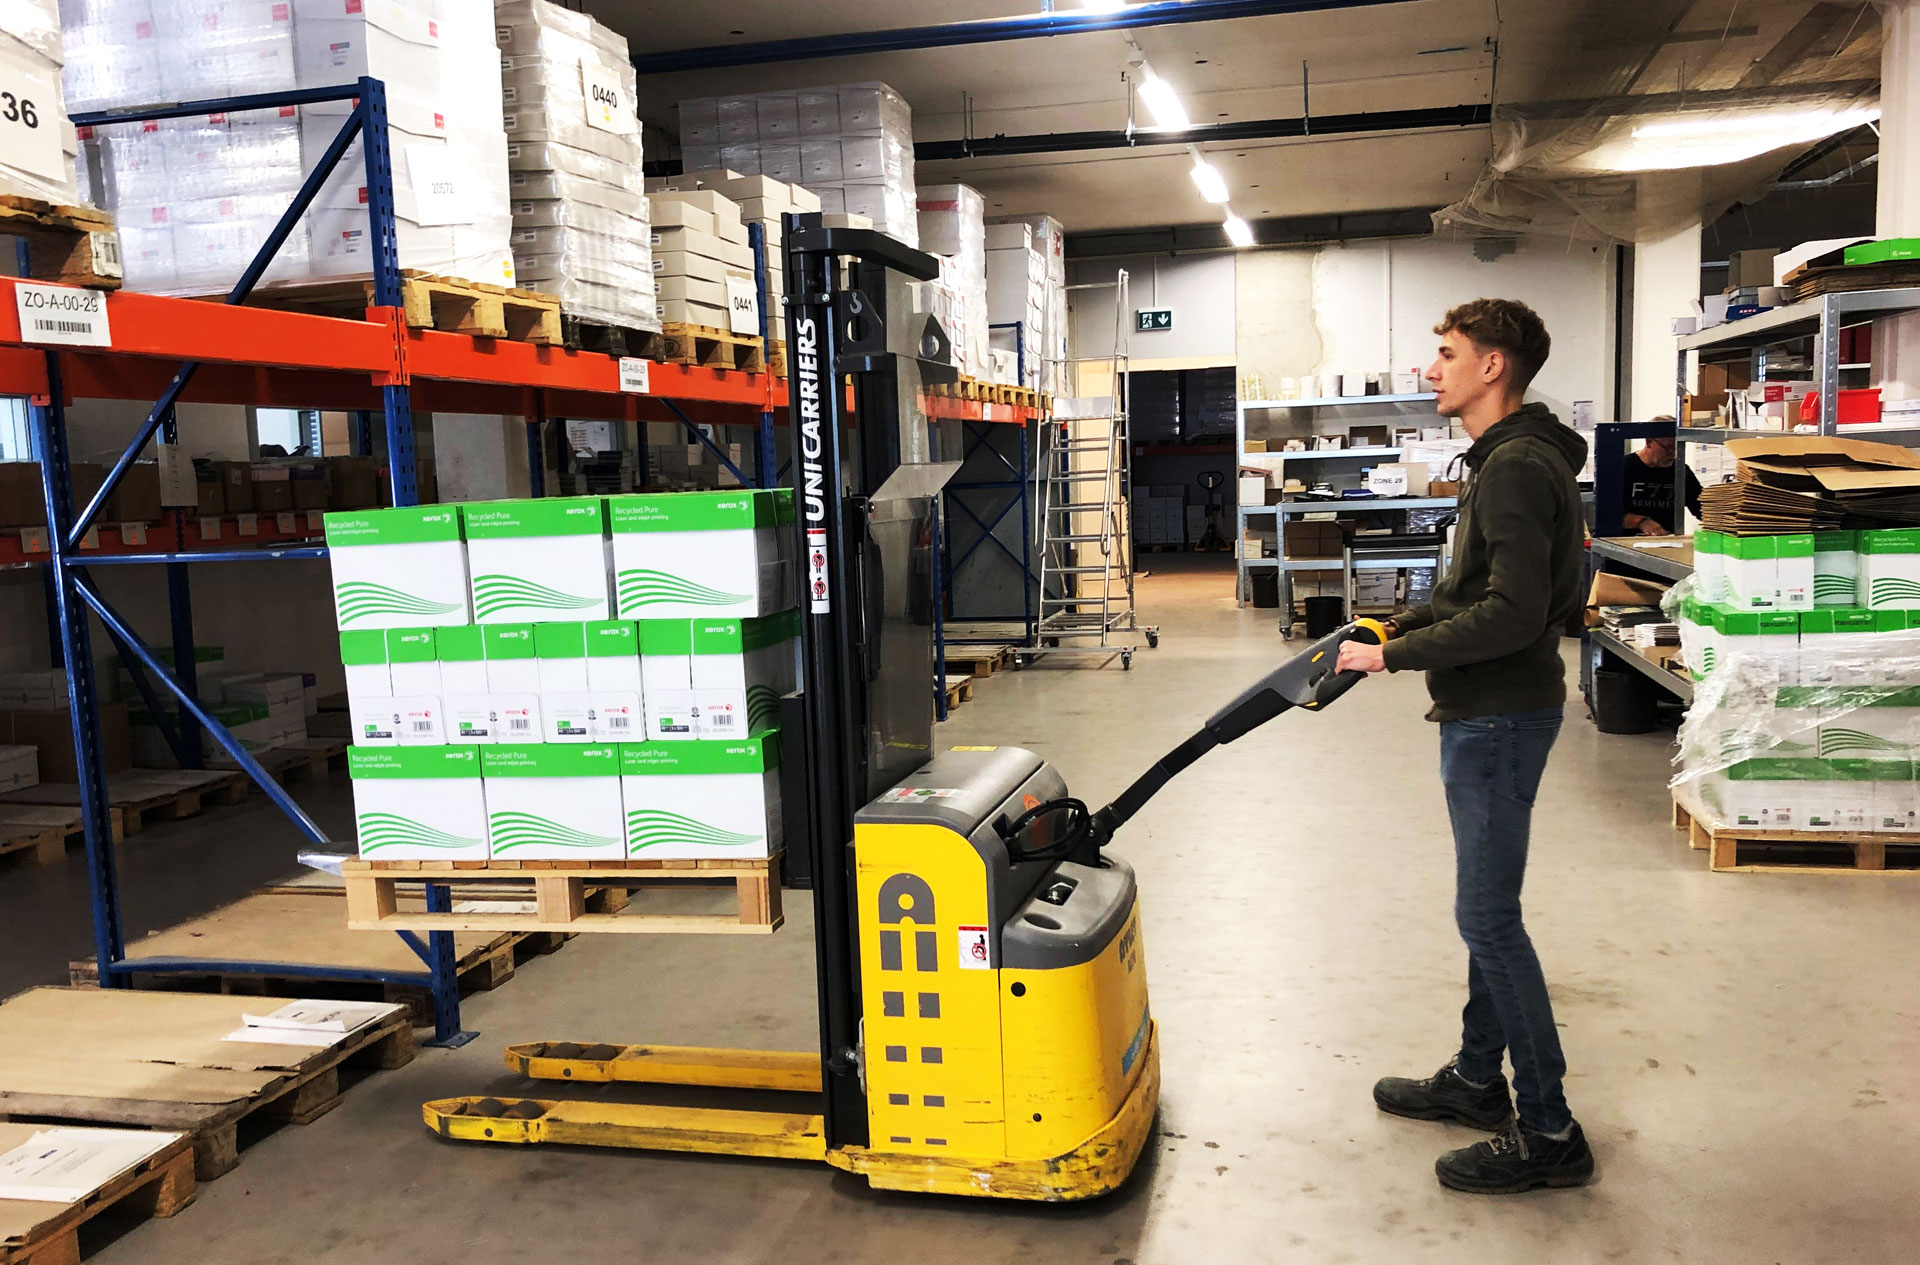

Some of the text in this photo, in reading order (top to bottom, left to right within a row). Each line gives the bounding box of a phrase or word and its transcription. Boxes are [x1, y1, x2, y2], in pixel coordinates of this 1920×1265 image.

[592, 84, 618, 109] 0440
[1, 91, 39, 129] 36
[23, 291, 99, 313] ZO-A-00-29
[733, 296, 753, 313] 0441
[796, 318, 826, 522] UNICARRIERS
[717, 502, 737, 510] xerox
[1630, 499, 1676, 509] ARMYME
[615, 506, 643, 515] Recycled
[468, 512, 495, 522] Recycled
[328, 520, 369, 530] Recycled Pure
[352, 754, 378, 763] Recycled
[485, 751, 527, 761] Recycled Pure
[623, 750, 652, 758] Recycled
